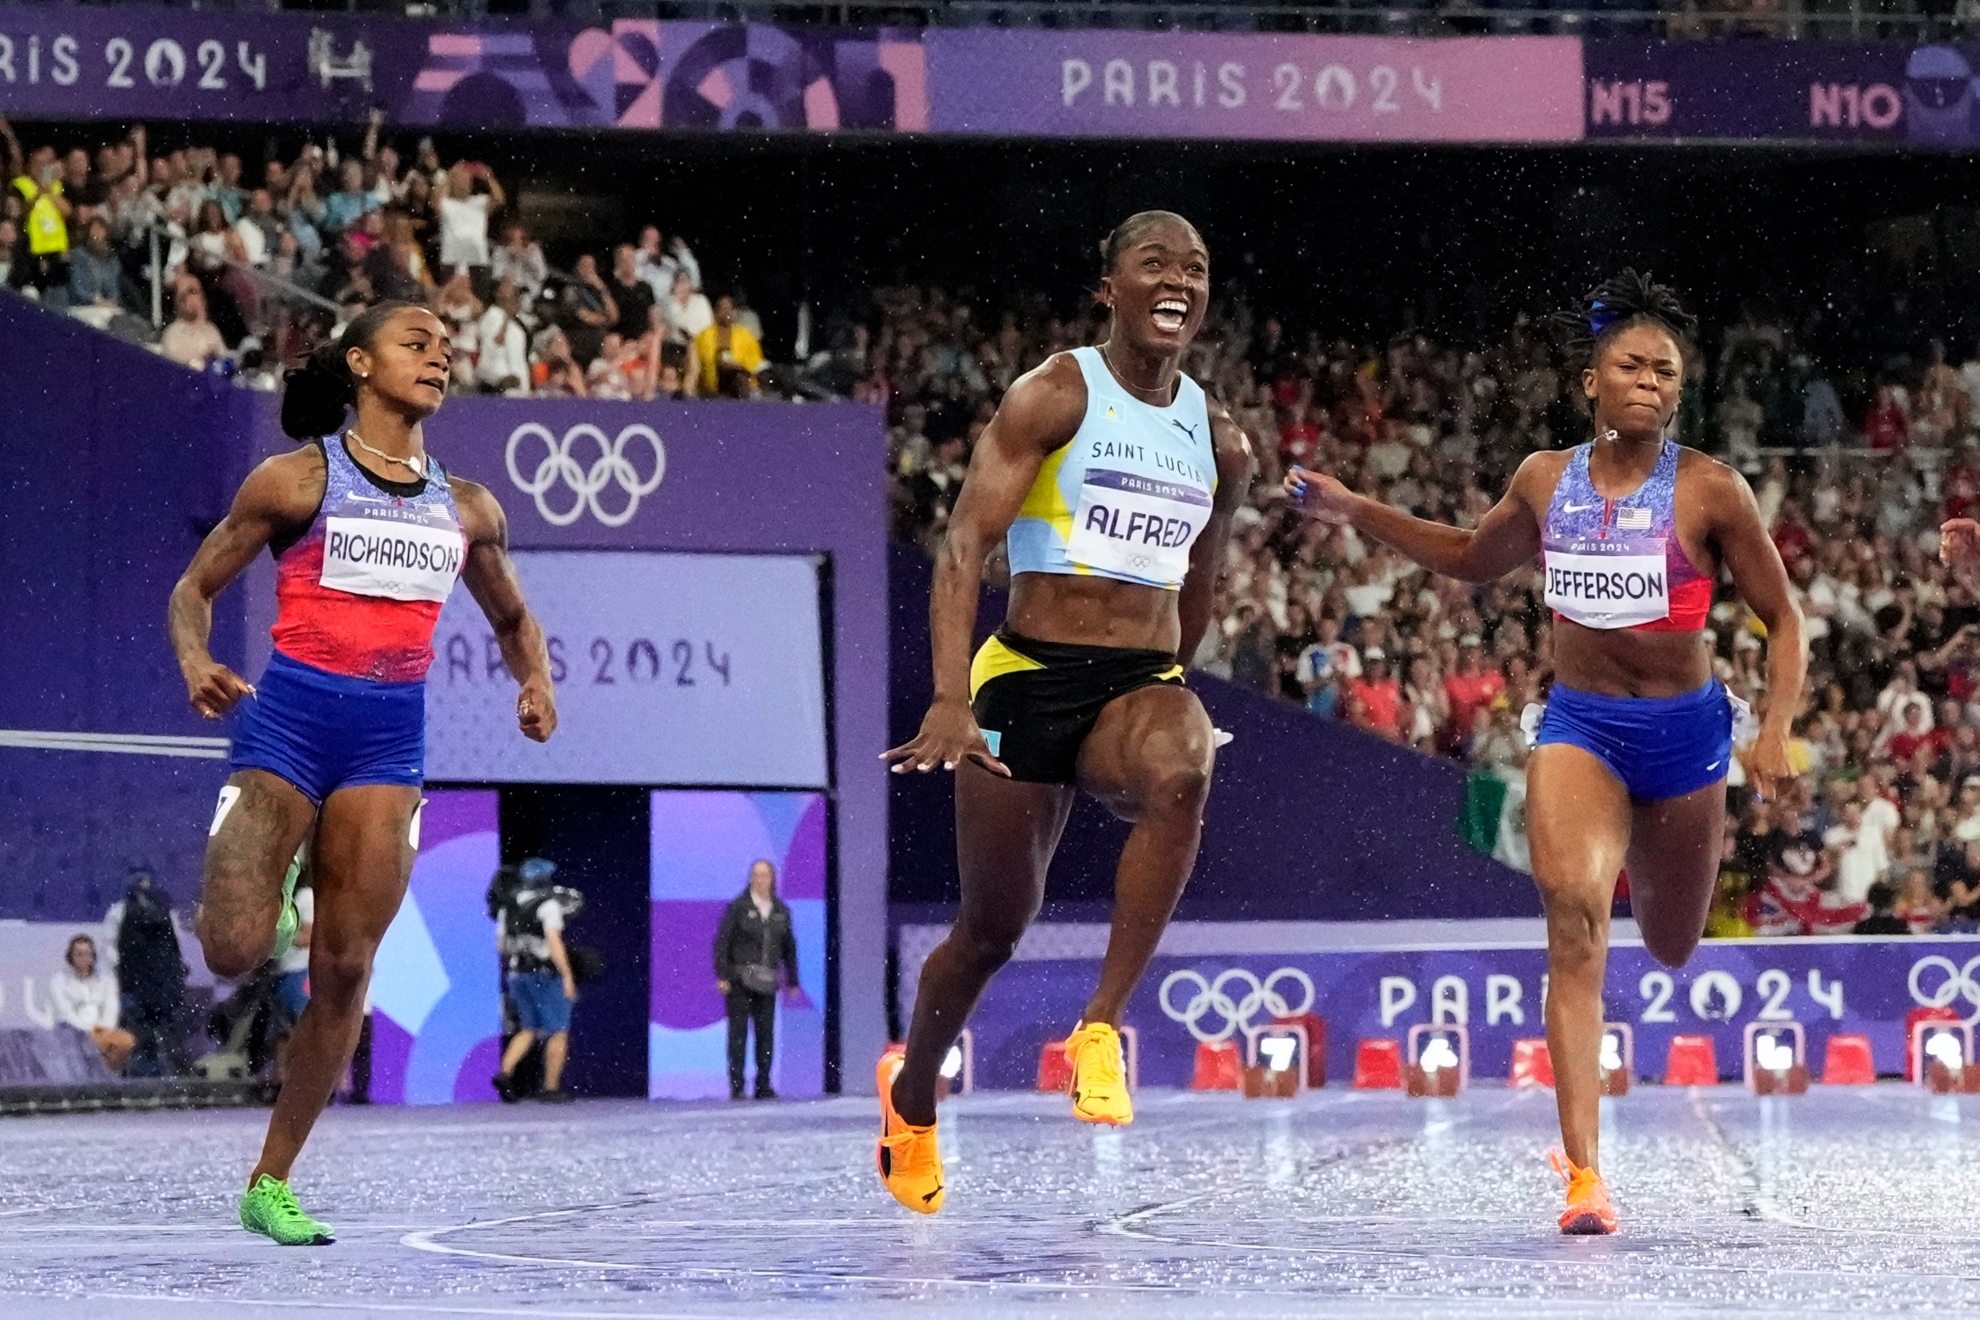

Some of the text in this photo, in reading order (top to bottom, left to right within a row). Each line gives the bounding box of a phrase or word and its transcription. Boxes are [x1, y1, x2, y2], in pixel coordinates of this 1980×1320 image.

[104, 36, 268, 90] 2024
[1061, 58, 1443, 112] PARIS 2024
[1591, 80, 1672, 126] N15
[1809, 82, 1901, 129] N10
[1091, 441, 1145, 462] SAINT
[1121, 477, 1186, 497] PARIS 2024
[364, 507, 429, 525] PARIS 2024
[1085, 504, 1192, 548] ALFRED
[329, 531, 460, 573] RICHARDSON
[1600, 542, 1630, 552] 2024
[1548, 567, 1663, 600] JEFFERSON
[590, 636, 731, 687] 2024
[1379, 968, 1844, 1028] PARI 2024
[1260, 1037, 1297, 1071] 7
